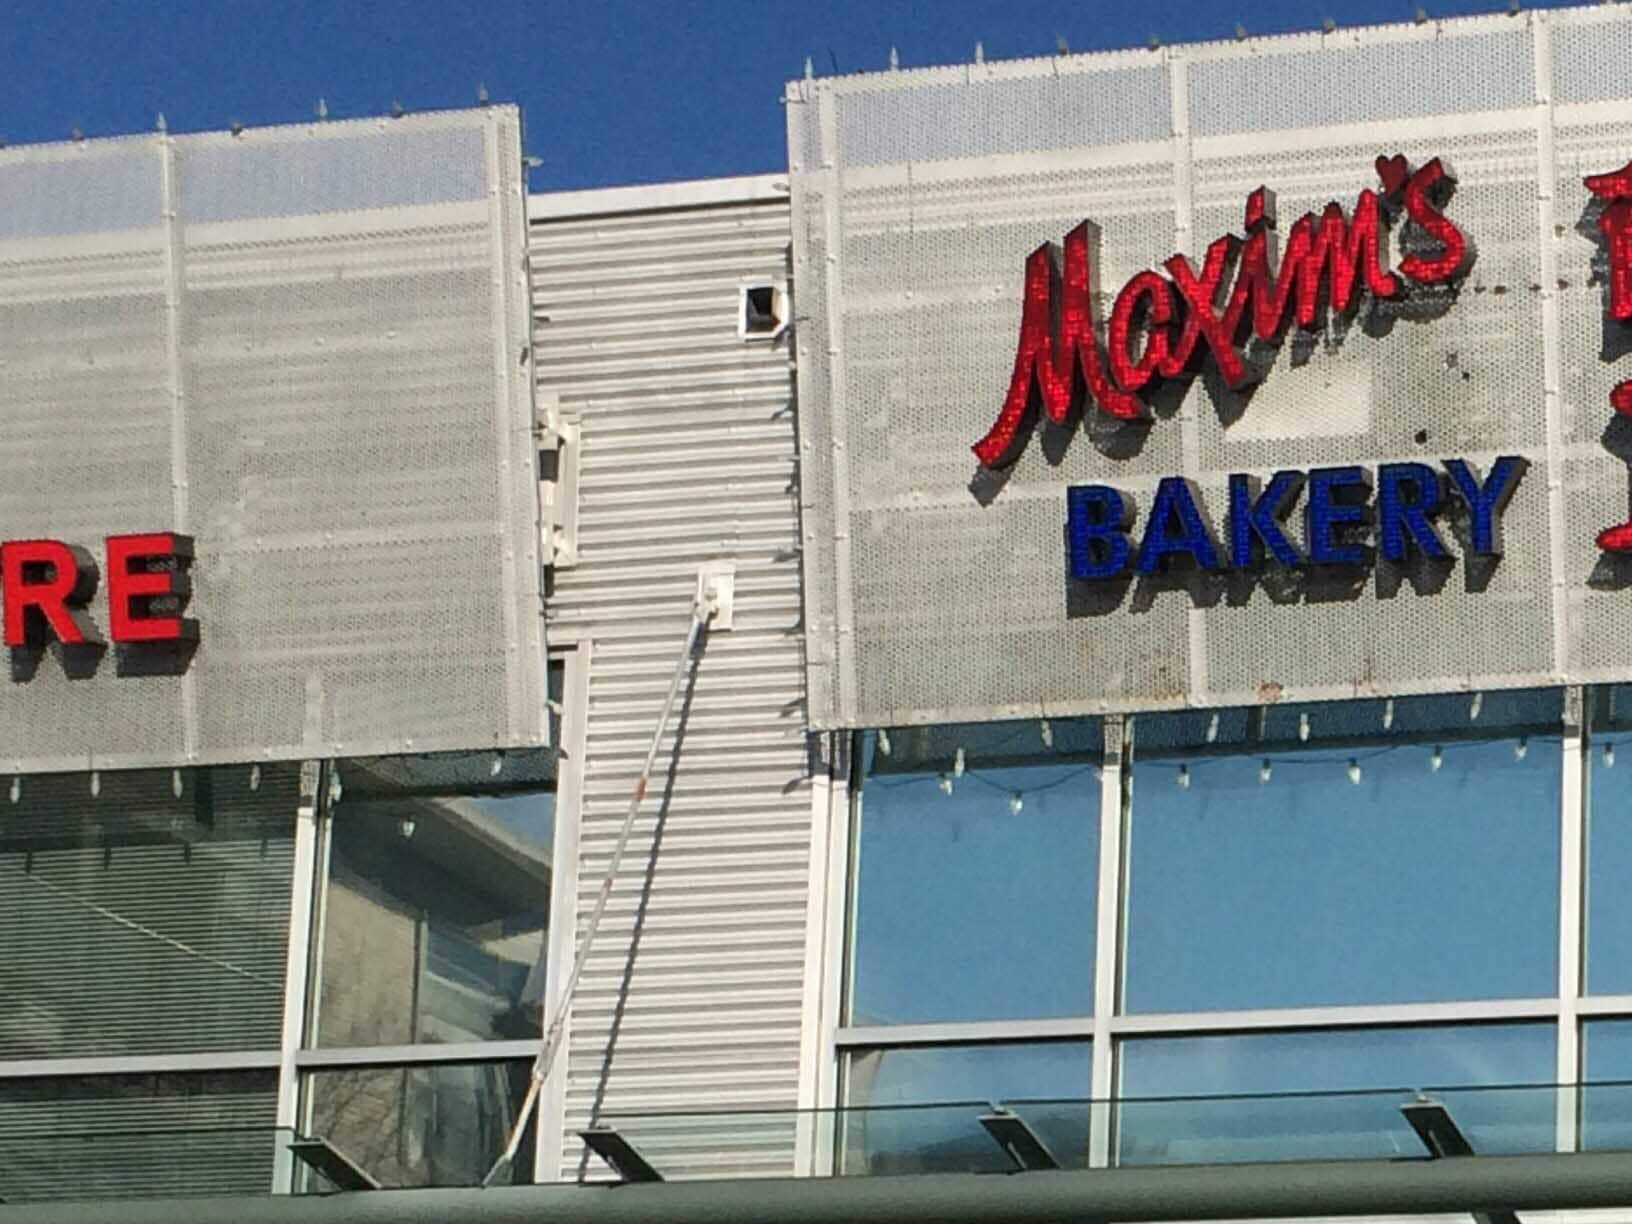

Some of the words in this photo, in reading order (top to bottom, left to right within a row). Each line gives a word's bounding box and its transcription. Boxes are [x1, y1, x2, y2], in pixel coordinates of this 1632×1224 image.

[972, 152, 1468, 466] Maxim's
[1066, 458, 1516, 582] BAKERY
[0, 531, 183, 648] RE
